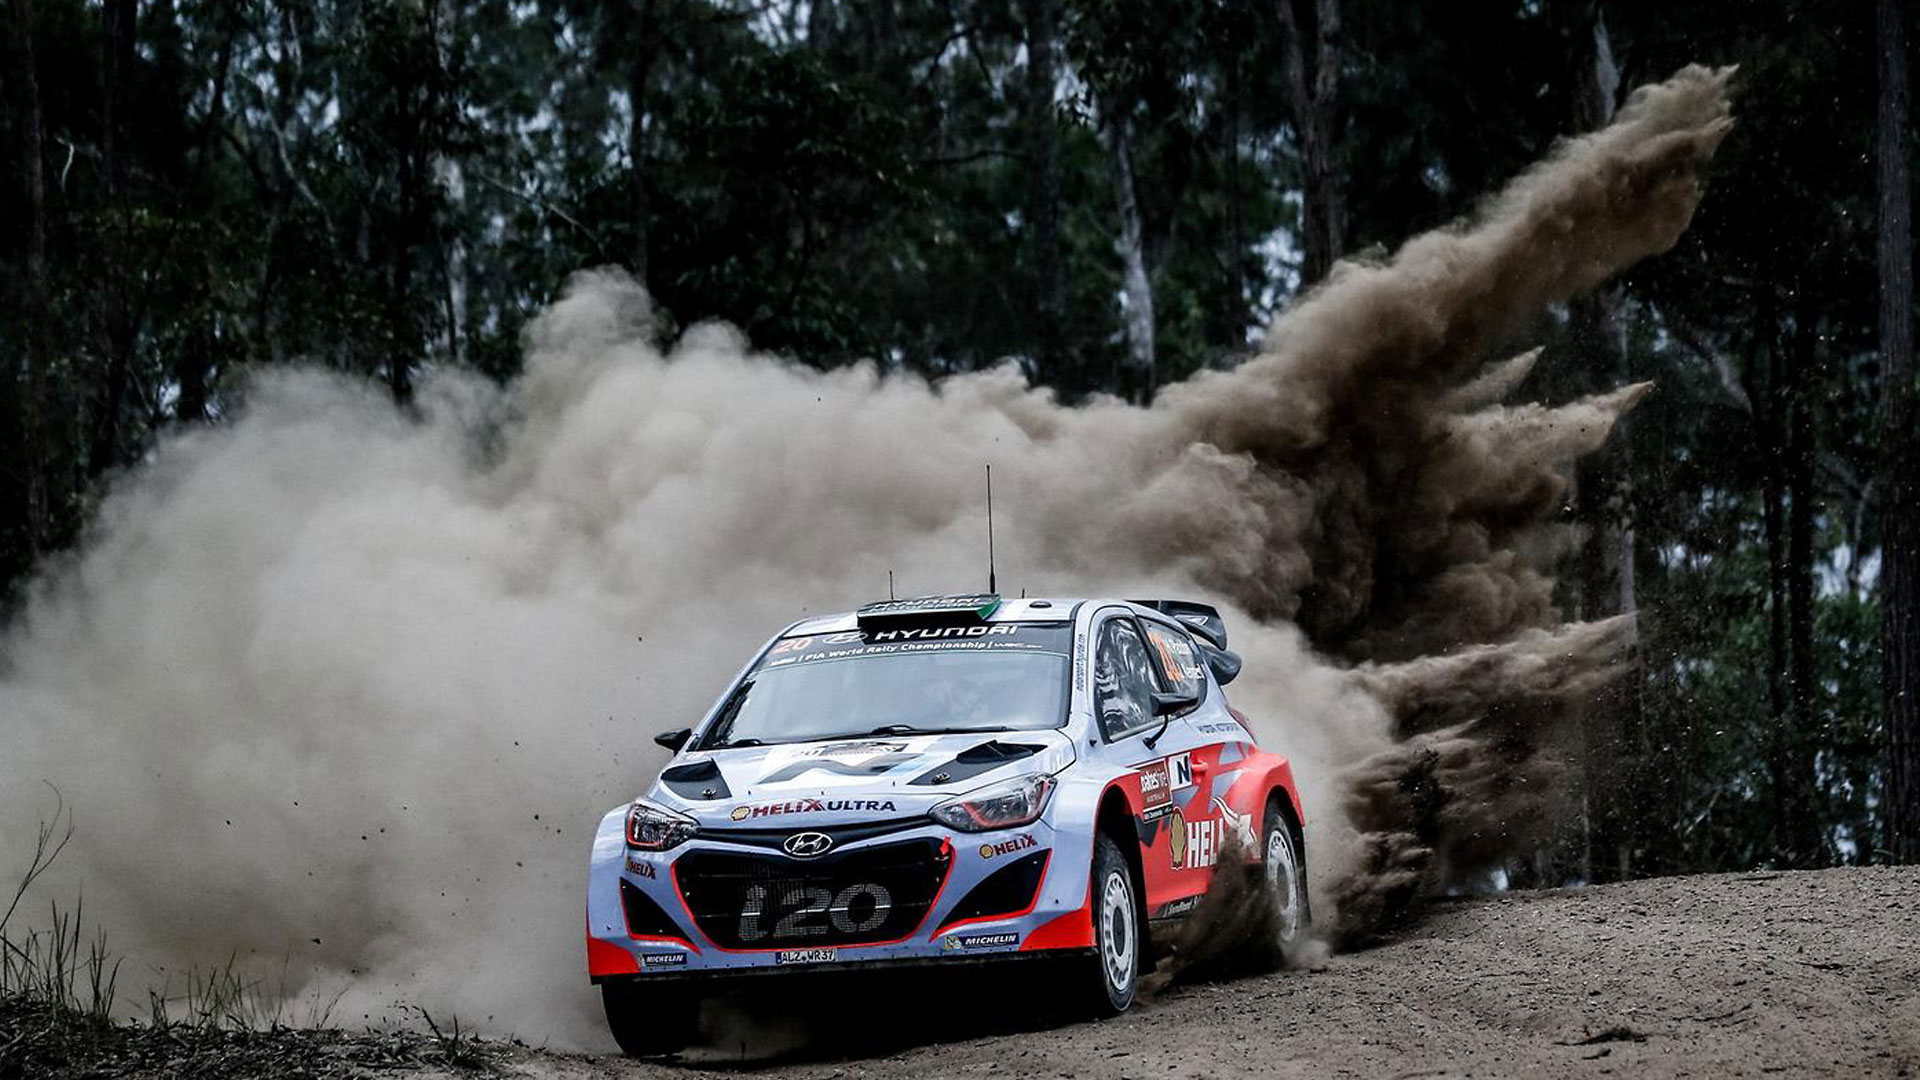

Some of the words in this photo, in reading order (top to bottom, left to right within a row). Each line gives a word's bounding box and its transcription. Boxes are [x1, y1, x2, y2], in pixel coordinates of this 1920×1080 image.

[773, 638, 813, 653] 20
[875, 625, 1018, 641] HYUNDAI
[805, 653, 825, 662] FIA
[829, 648, 863, 659] World
[867, 644, 898, 655] Rally
[901, 639, 986, 651] Championship
[1176, 755, 1190, 784] N
[827, 800, 896, 812] ULTRA
[738, 883, 892, 941] i20
[965, 934, 1017, 945] MICHELIN
[646, 953, 684, 963] MICHELIN
